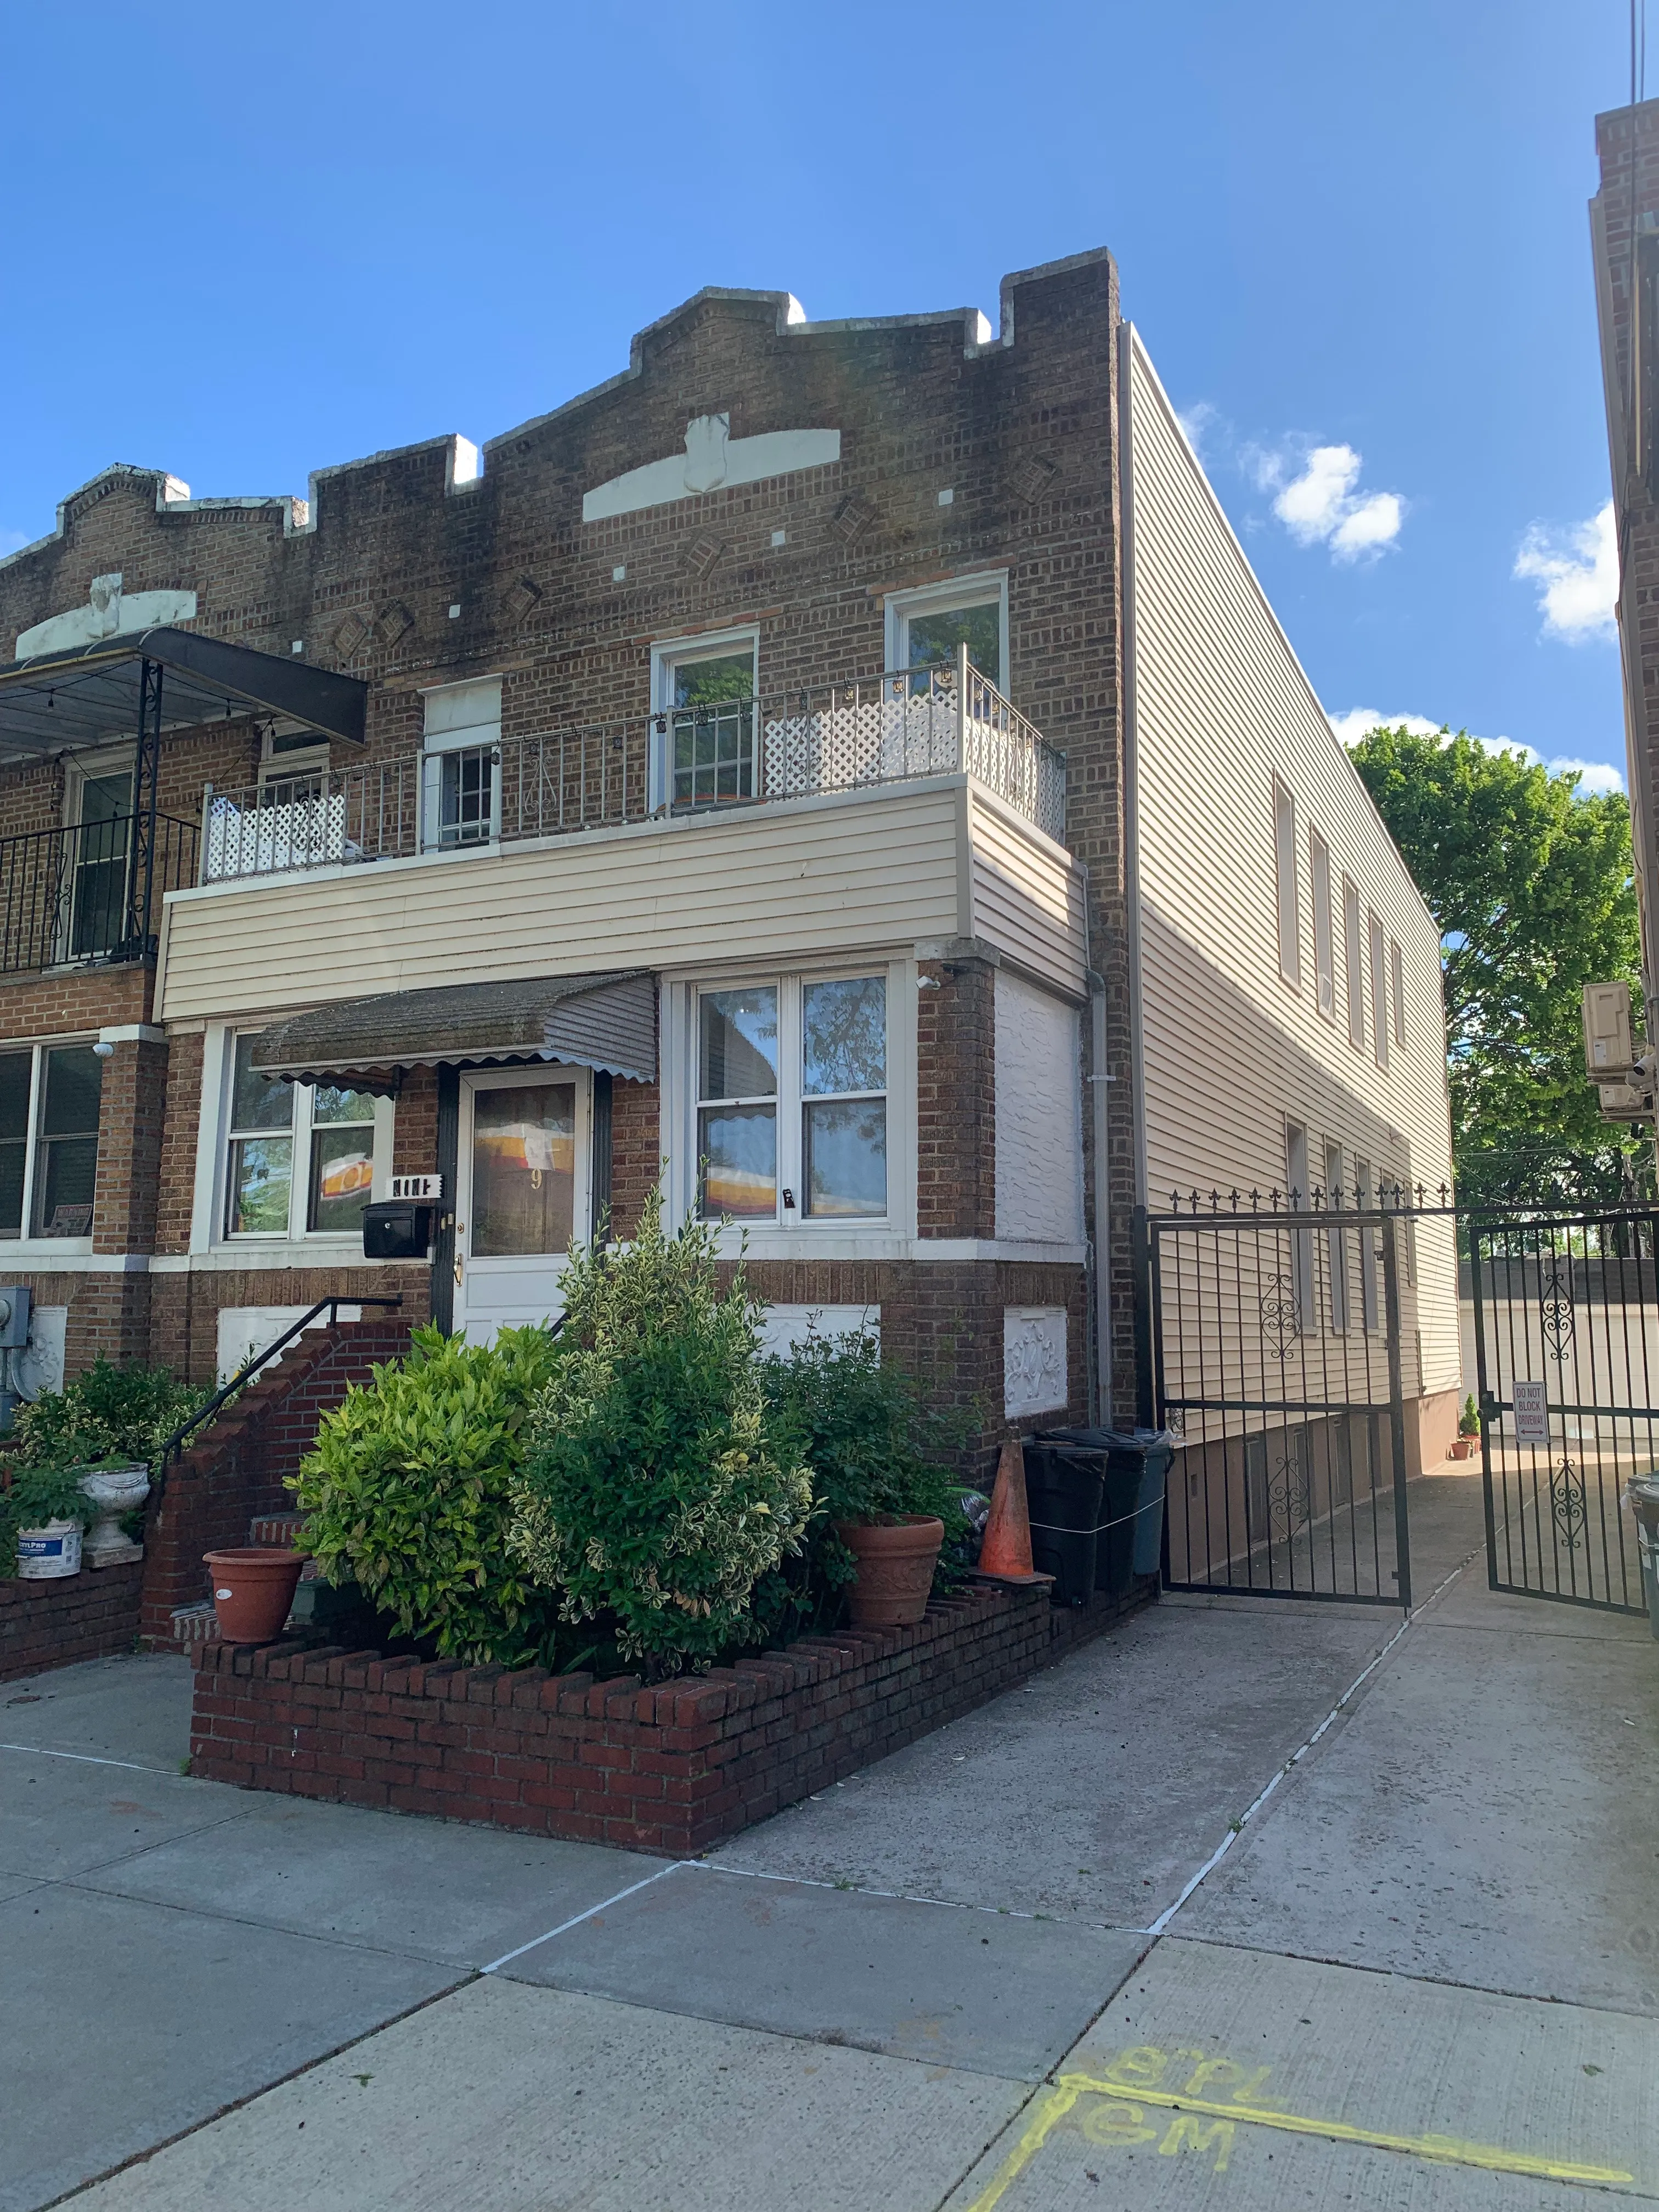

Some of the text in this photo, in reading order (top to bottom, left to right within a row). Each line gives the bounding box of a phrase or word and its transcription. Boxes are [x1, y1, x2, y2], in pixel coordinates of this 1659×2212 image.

[531, 1167, 542, 1190] 9
[1516, 1388, 1541, 1398] DO NOT
[1519, 1401, 1541, 1411] BLOCK
[1518, 1415, 1543, 1425] DRIVEWAY
